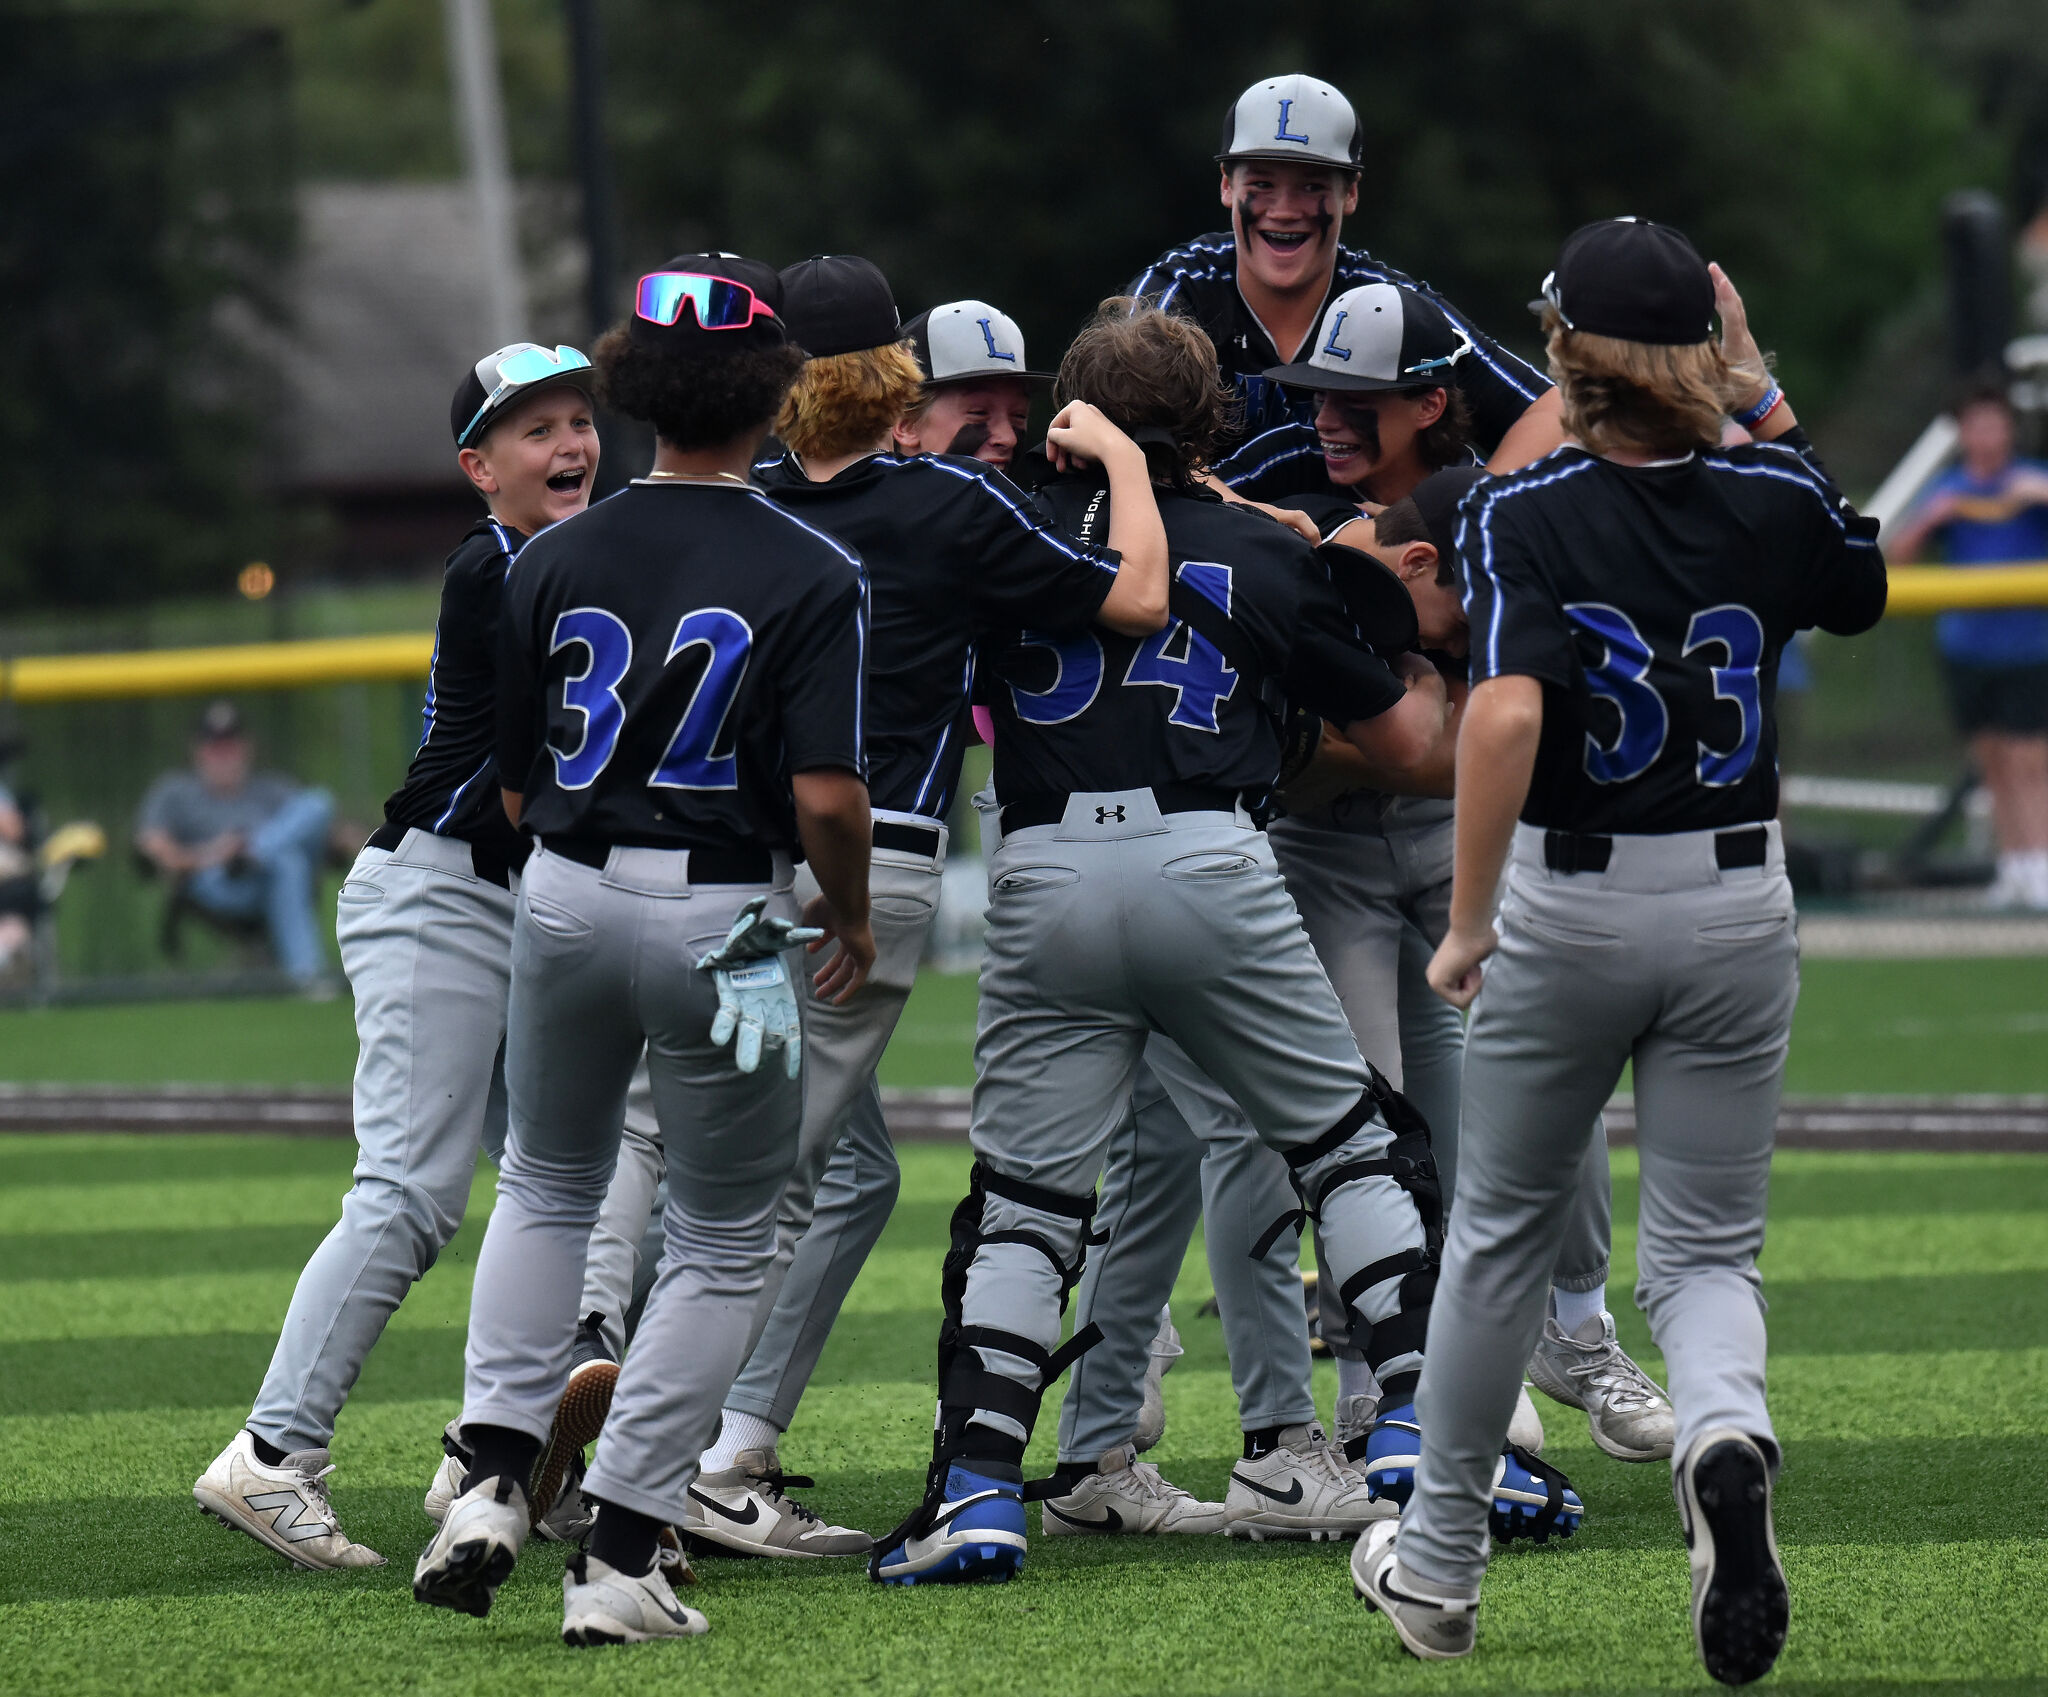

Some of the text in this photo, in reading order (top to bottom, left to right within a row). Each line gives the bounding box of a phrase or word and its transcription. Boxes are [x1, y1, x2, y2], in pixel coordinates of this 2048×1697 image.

[1275, 99, 1309, 145] L
[976, 318, 1015, 362] L
[1323, 311, 1352, 361] L
[546, 607, 753, 791] 32
[1562, 603, 1764, 788] 33
